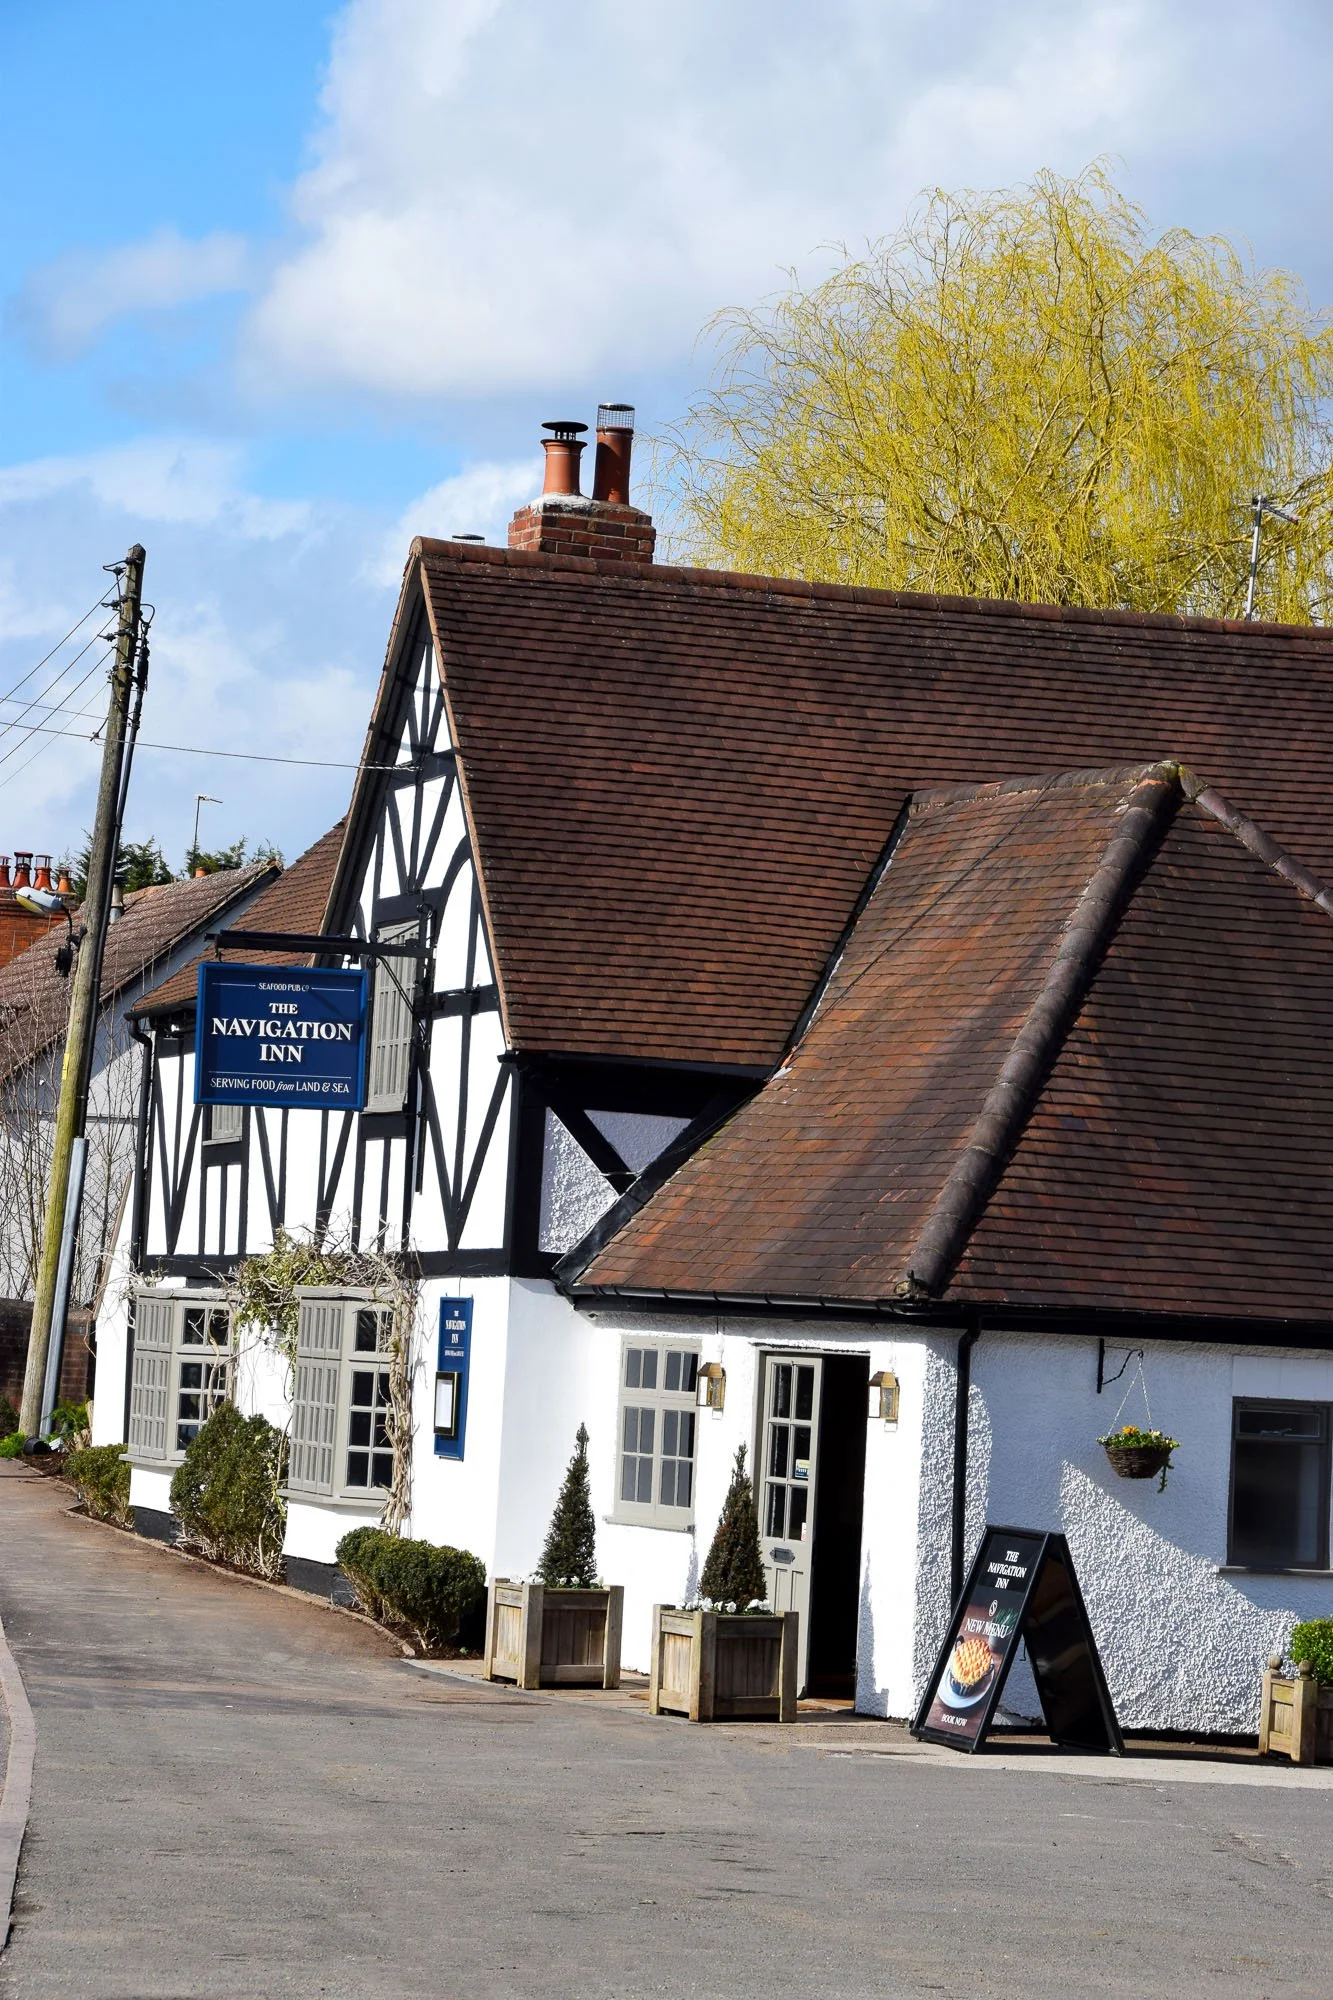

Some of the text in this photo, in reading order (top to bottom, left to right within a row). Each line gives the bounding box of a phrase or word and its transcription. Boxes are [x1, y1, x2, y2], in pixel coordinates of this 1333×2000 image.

[258, 982, 287, 991] SEAFOOD
[287, 984, 301, 992] PUB
[269, 1002, 298, 1014] THE
[211, 1018, 353, 1040] NAVIGATION
[259, 1043, 304, 1063] INN
[210, 1077, 350, 1093] SERVING FOOD from LAND & SEA
[1005, 1550, 1020, 1562] THE
[987, 1562, 1027, 1578] NAVIGATION
[995, 1577, 1009, 1589] INN
[965, 1618, 1009, 1638] NEW MENU
[941, 1714, 967, 1726] BOOK NOW
